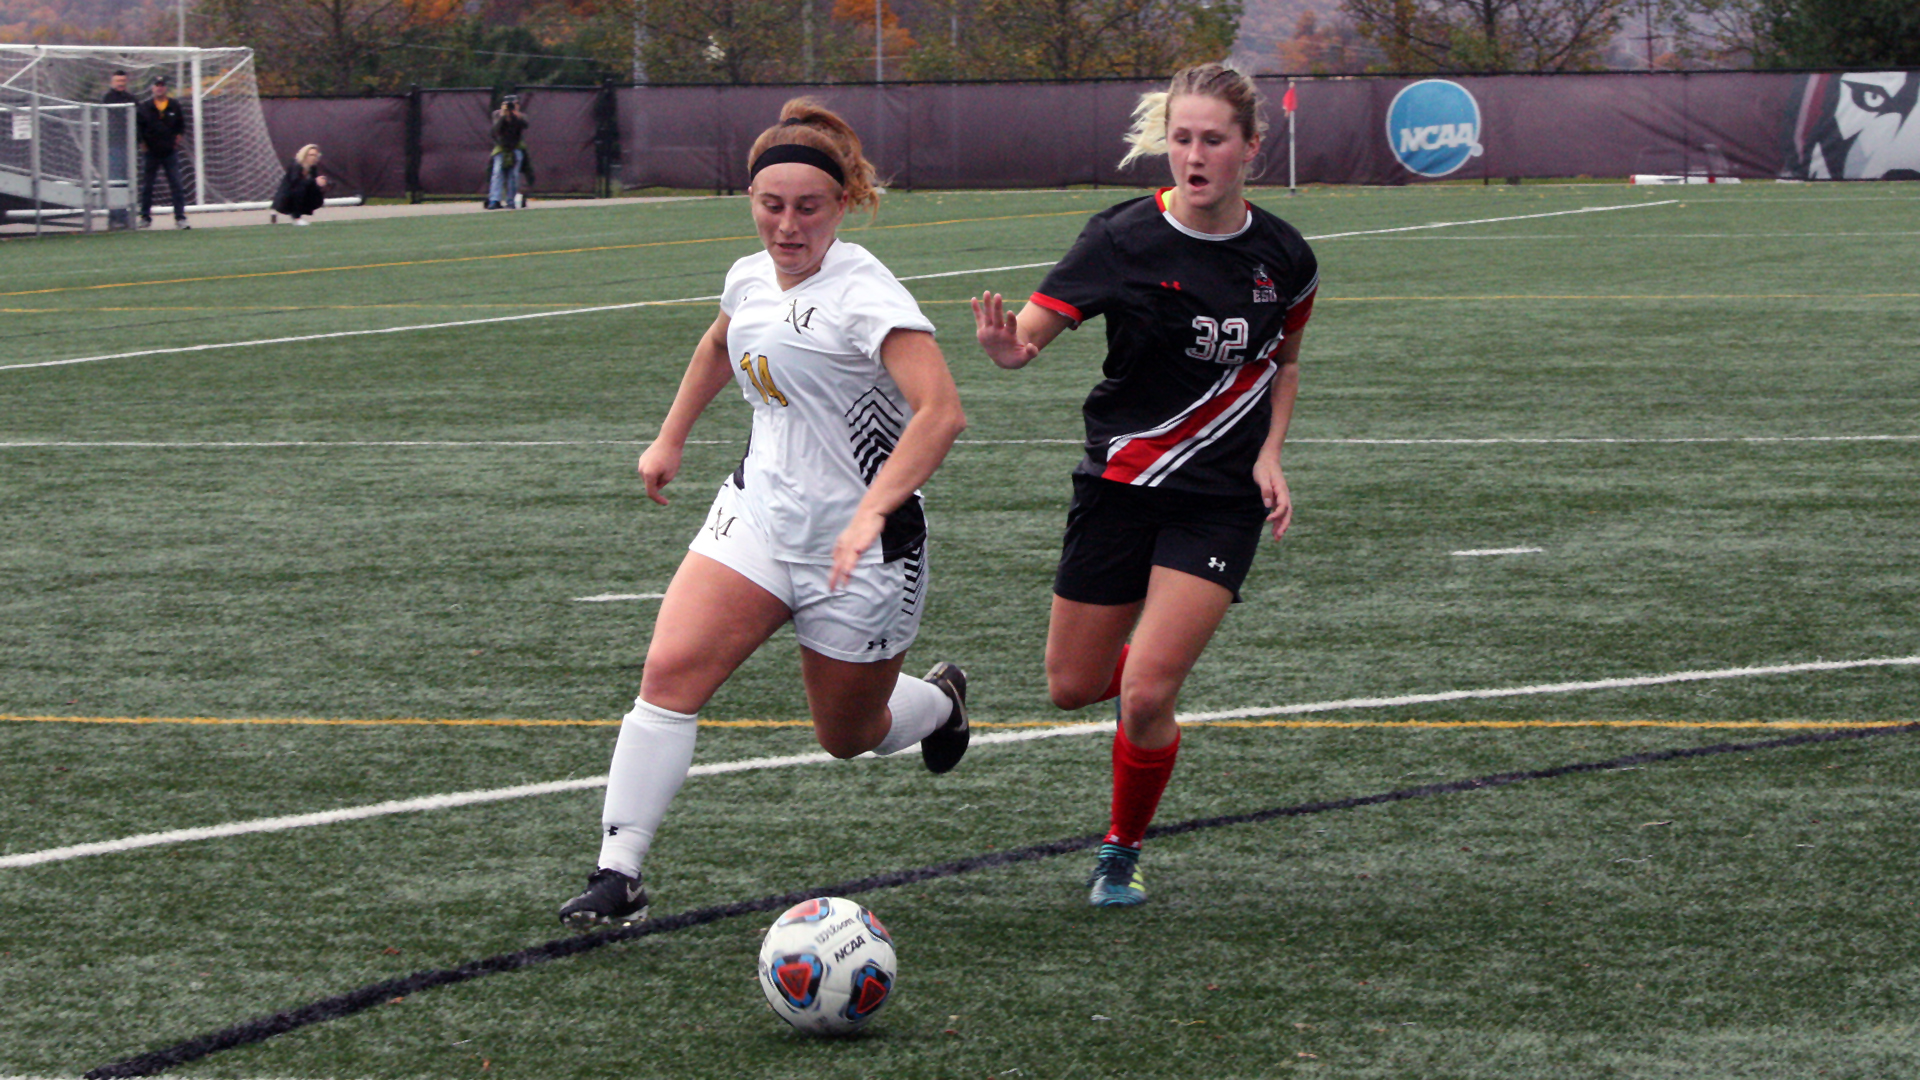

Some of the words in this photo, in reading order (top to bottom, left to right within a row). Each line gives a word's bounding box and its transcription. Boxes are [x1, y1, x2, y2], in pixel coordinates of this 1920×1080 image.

[1400, 122, 1475, 153] NCAA
[1252, 289, 1278, 303] ESU
[1185, 315, 1249, 365] 32
[814, 917, 856, 945] Wilson
[833, 935, 866, 963] NCAA
